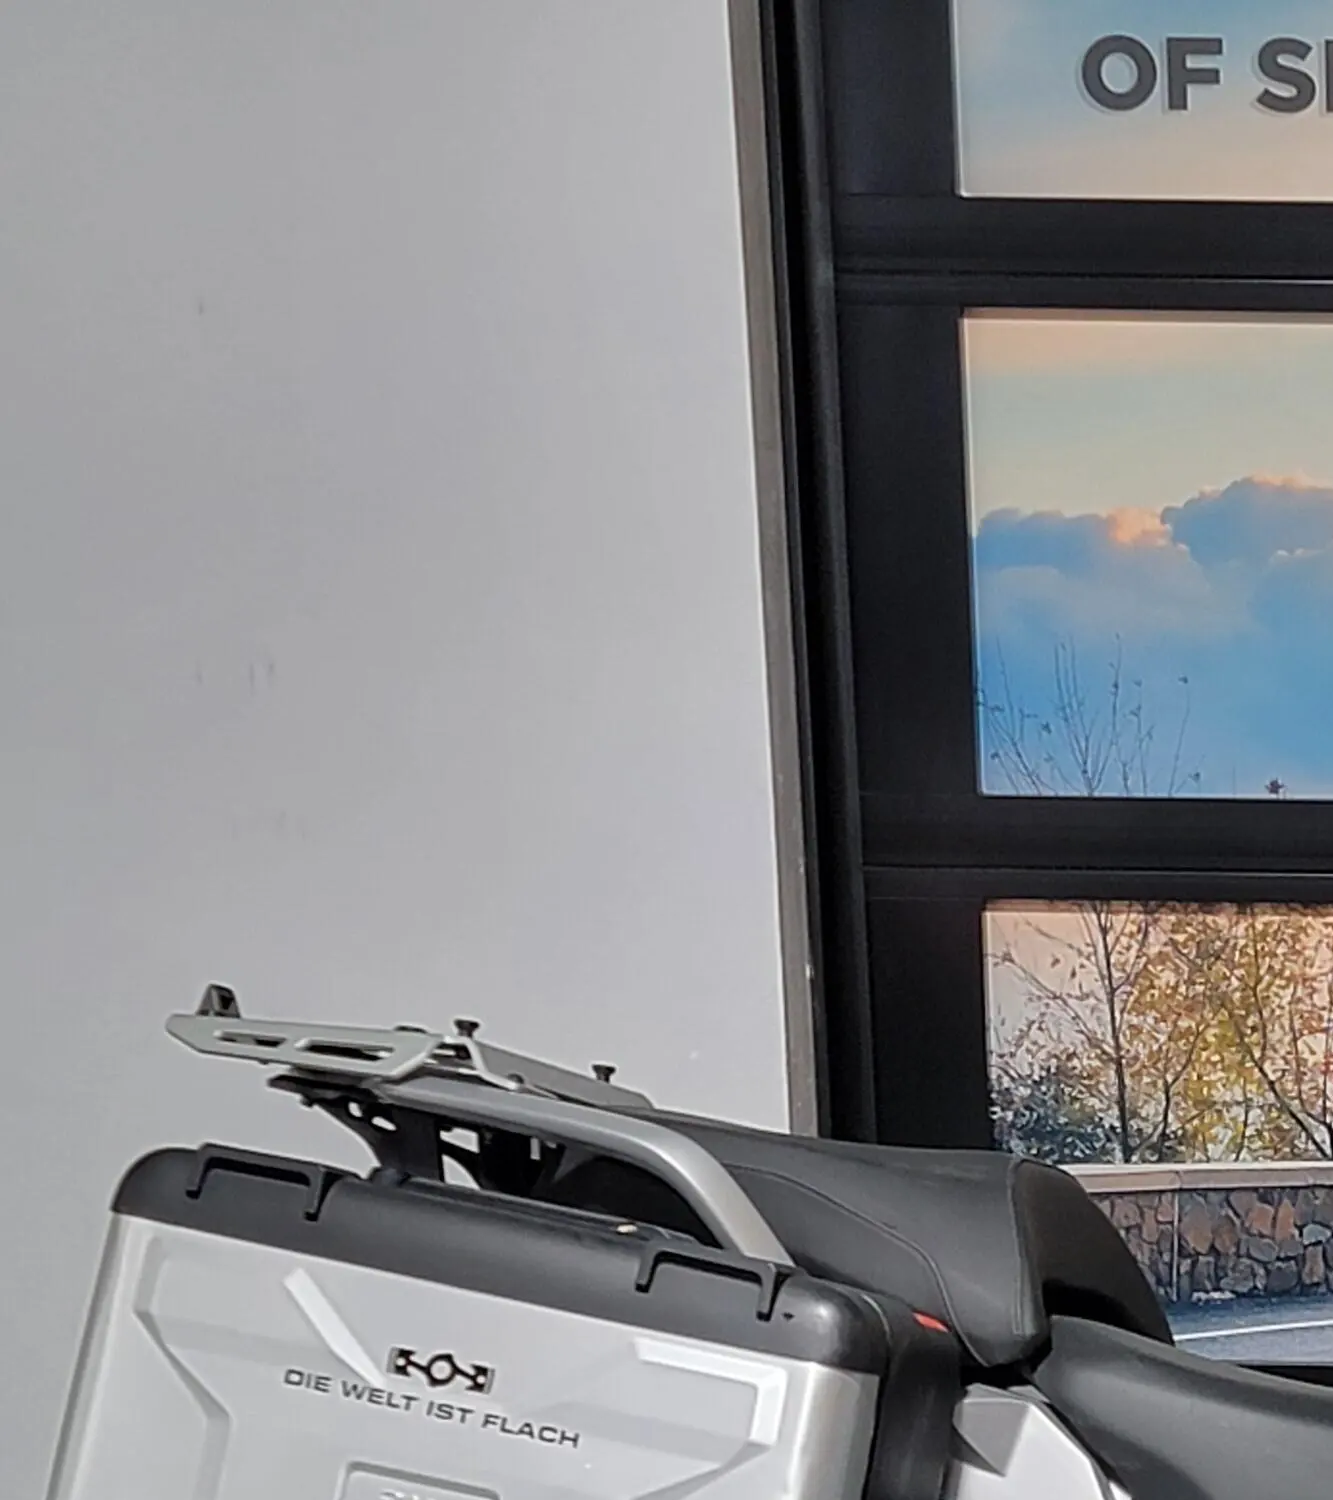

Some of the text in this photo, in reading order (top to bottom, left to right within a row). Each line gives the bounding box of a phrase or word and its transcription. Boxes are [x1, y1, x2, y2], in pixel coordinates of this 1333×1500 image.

[1080, 33, 1223, 112] OF
[284, 1368, 581, 1448] DIE WELT IST FLACH
